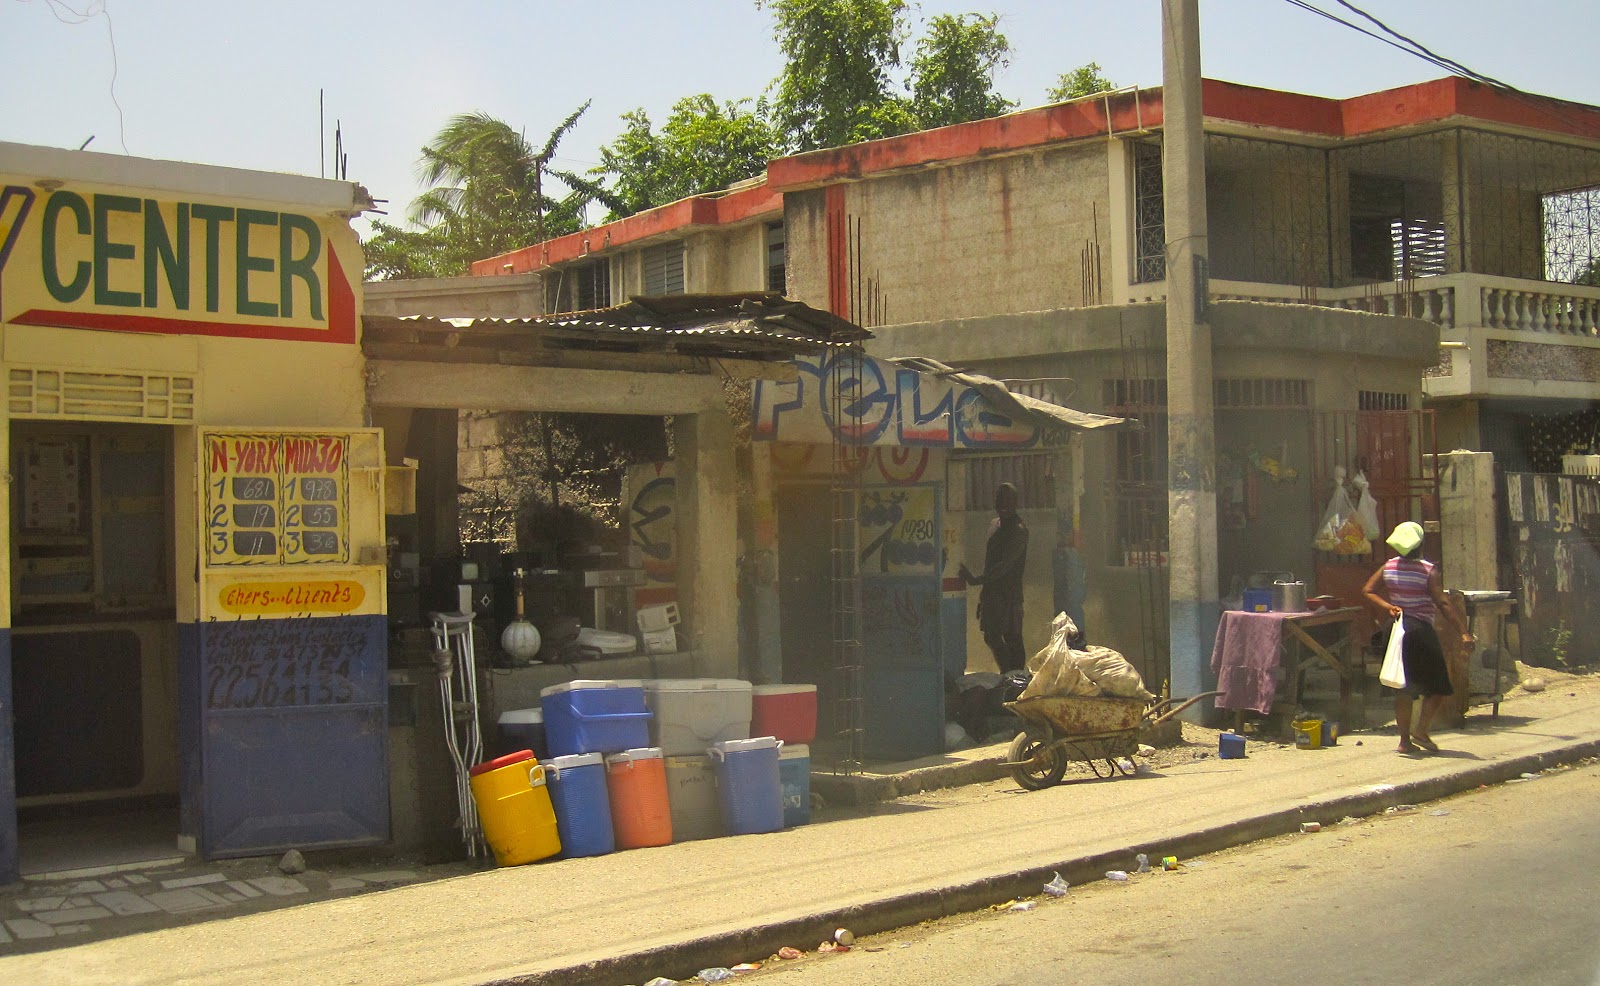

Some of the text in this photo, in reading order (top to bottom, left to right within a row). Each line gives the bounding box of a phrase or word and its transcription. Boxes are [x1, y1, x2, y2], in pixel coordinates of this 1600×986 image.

[41, 190, 326, 322] CENTER
[211, 439, 280, 474] N-YORK
[213, 476, 270, 499] 1 681
[285, 476, 297, 500] 1
[210, 503, 229, 527] 2
[285, 504, 332, 528] 2 55
[212, 531, 228, 555] 3
[285, 531, 300, 555] 3
